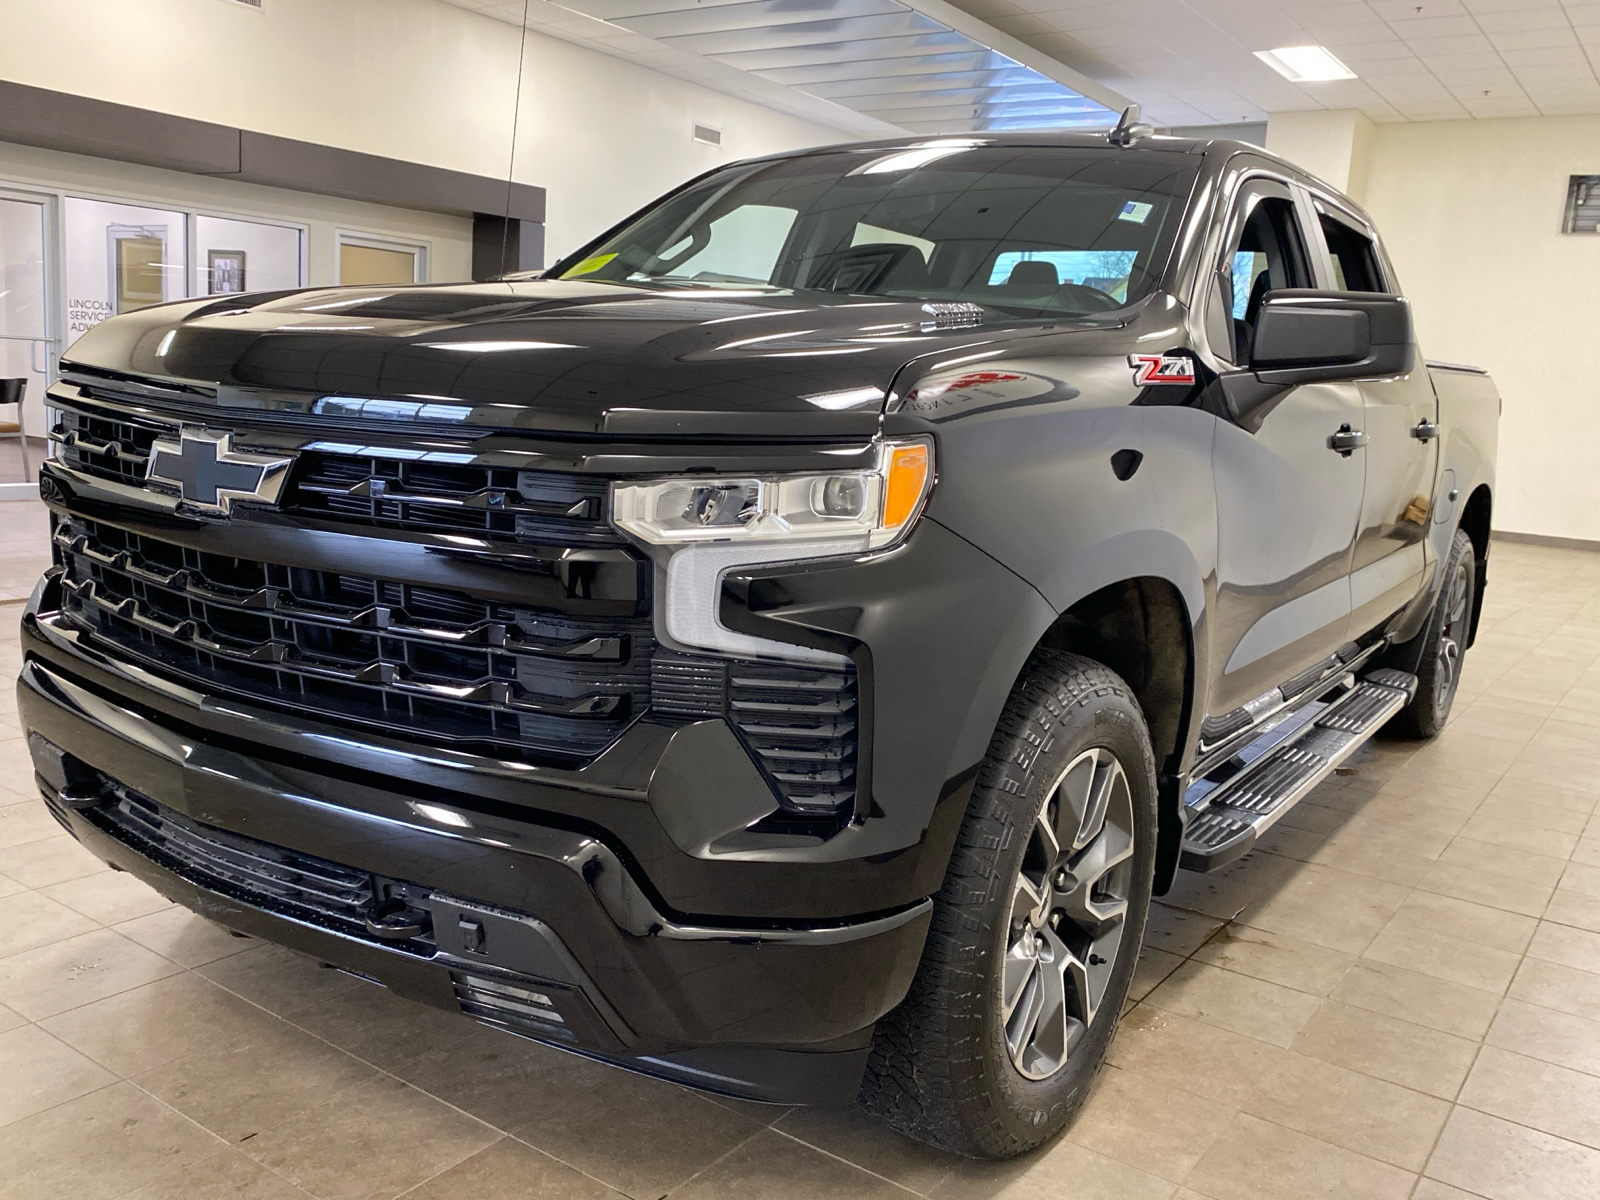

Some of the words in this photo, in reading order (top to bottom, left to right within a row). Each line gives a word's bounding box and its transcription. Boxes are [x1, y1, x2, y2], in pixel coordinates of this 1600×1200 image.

[69, 299, 113, 311] LINCOLN
[69, 310, 109, 321] SERVICE
[1125, 353, 1195, 387] Z71
